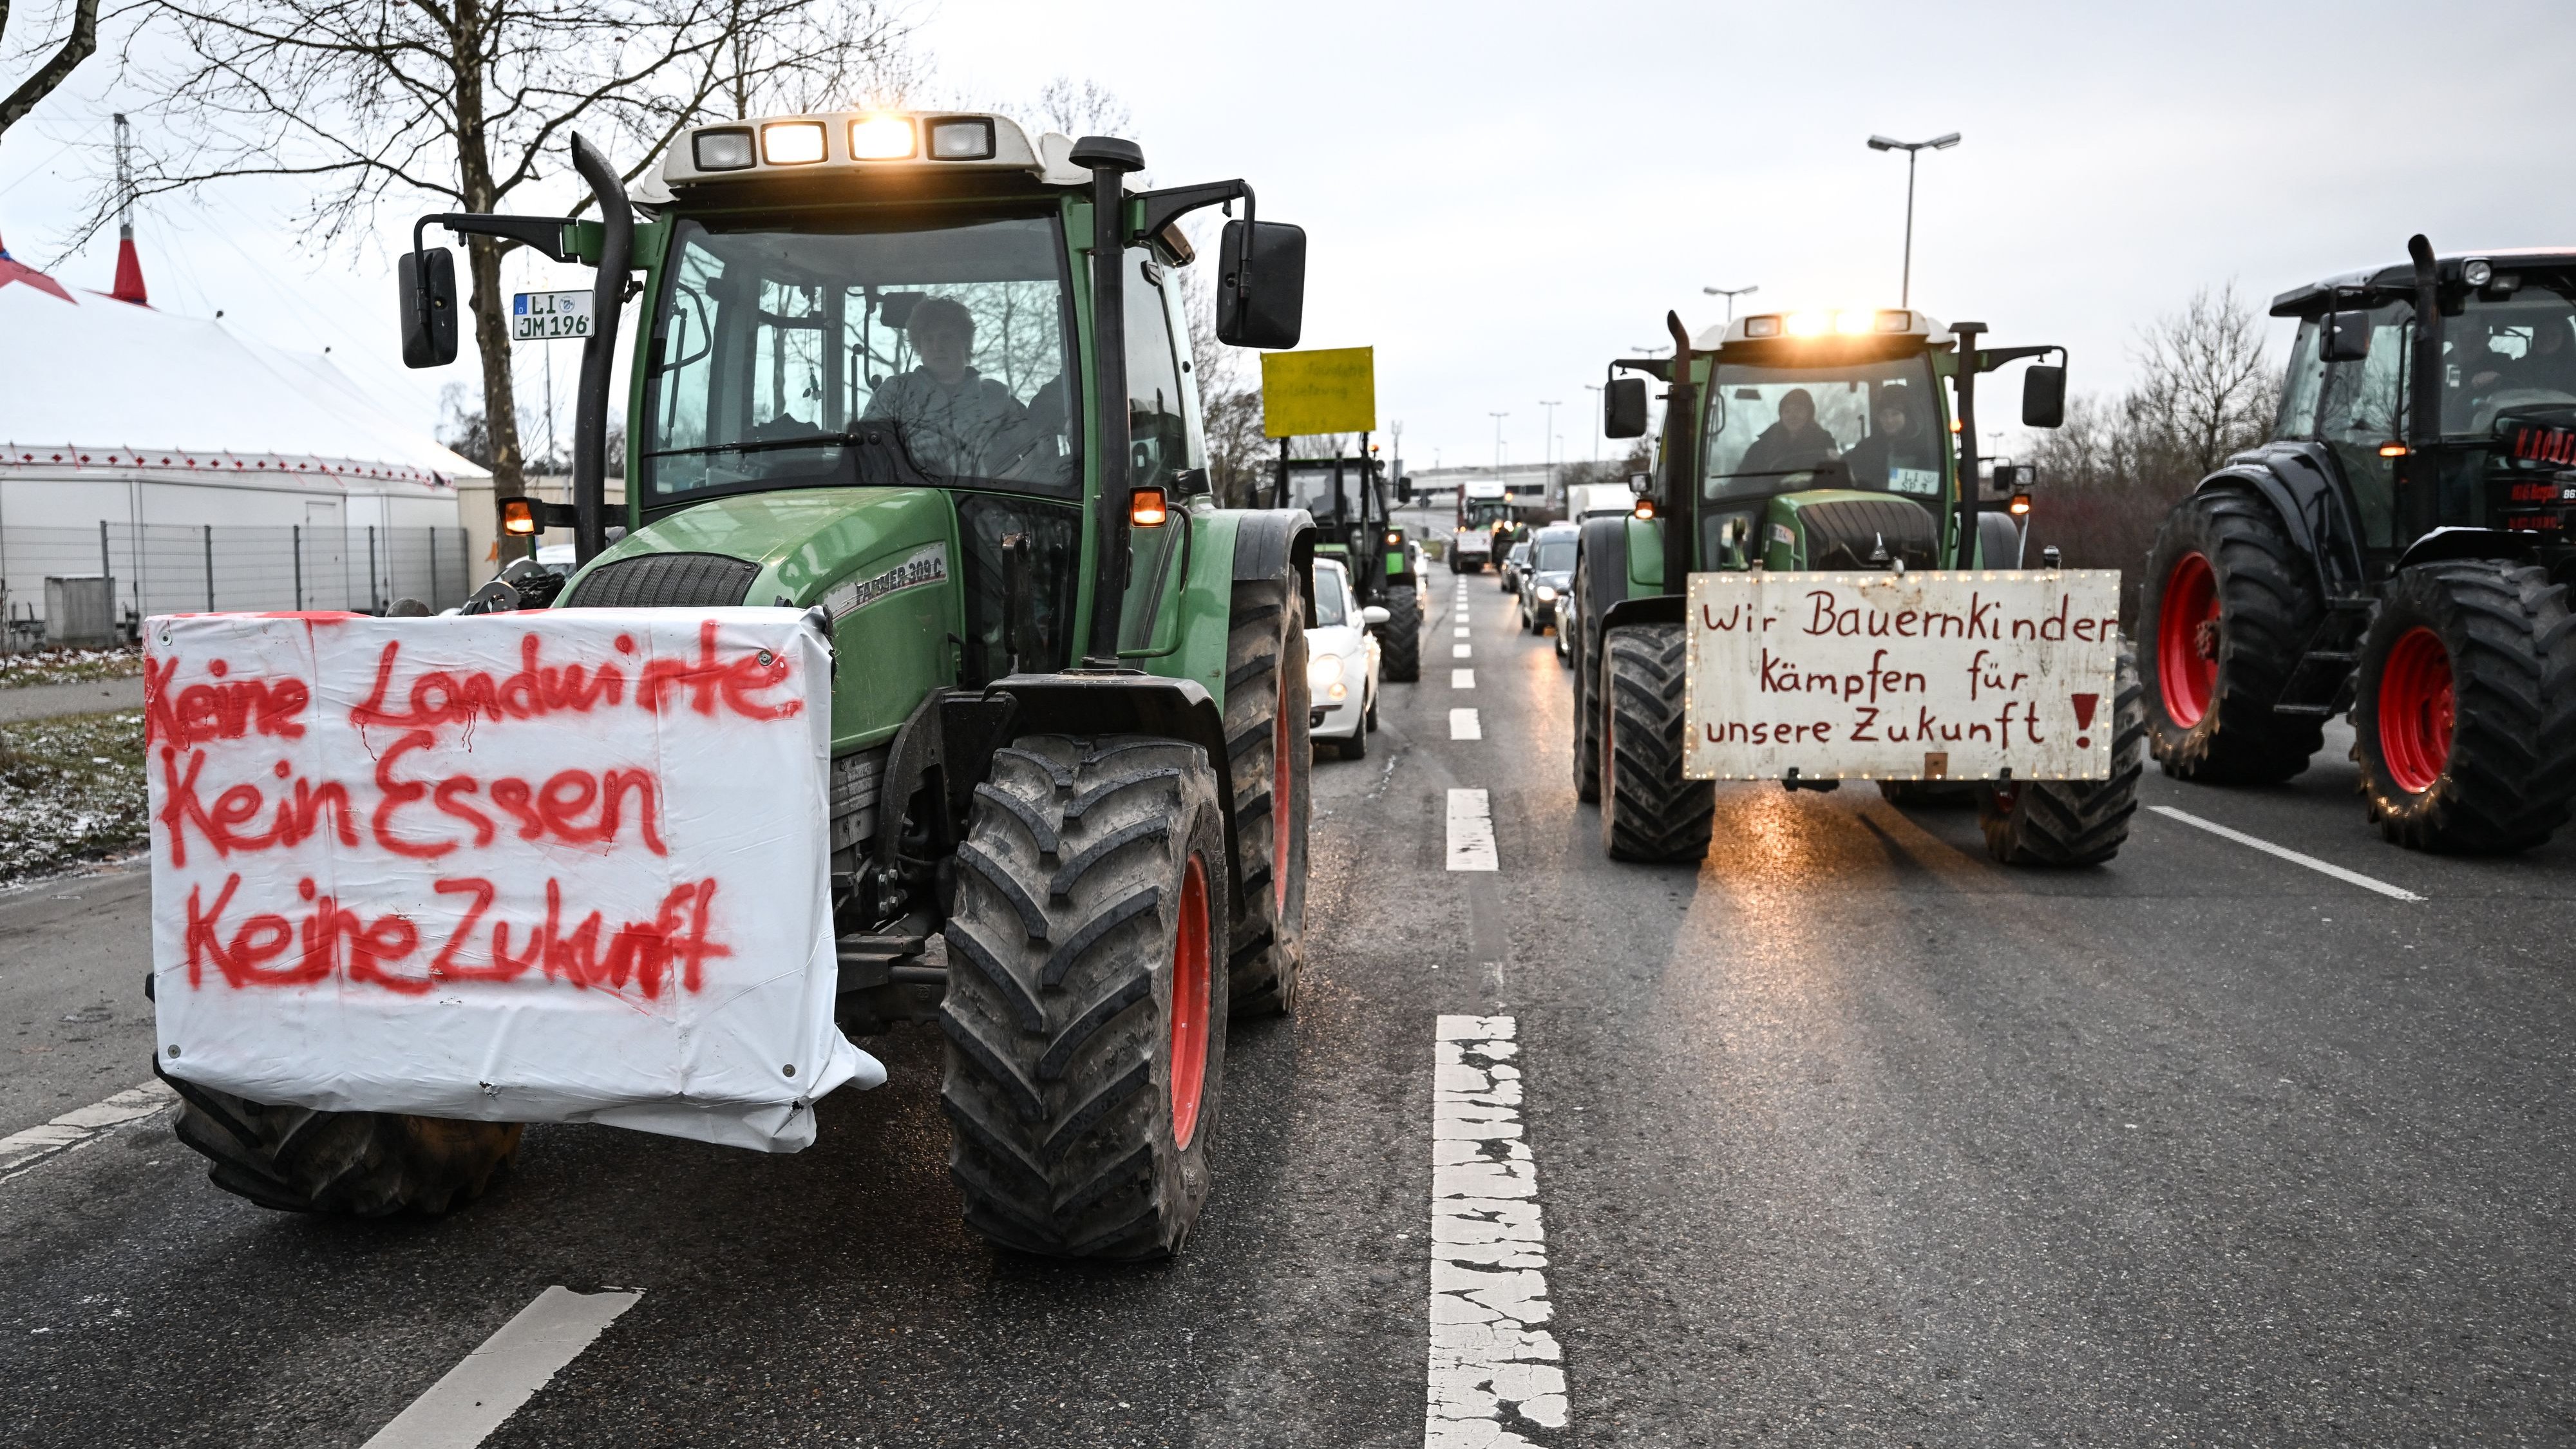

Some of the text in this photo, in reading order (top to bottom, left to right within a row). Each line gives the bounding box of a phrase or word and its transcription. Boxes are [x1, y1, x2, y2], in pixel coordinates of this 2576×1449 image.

[519, 314, 587, 337] JM 196
[532, 294, 556, 315] LI
[856, 558, 942, 605] FARMER 309 C
[1967, 649, 2028, 700] für
[144, 656, 310, 750] Keine
[1707, 719, 1831, 745] unsere
[1850, 701, 2045, 749] Zukunft
[158, 730, 667, 868] Kein Essen
[185, 872, 732, 999] Keine Zukunft
